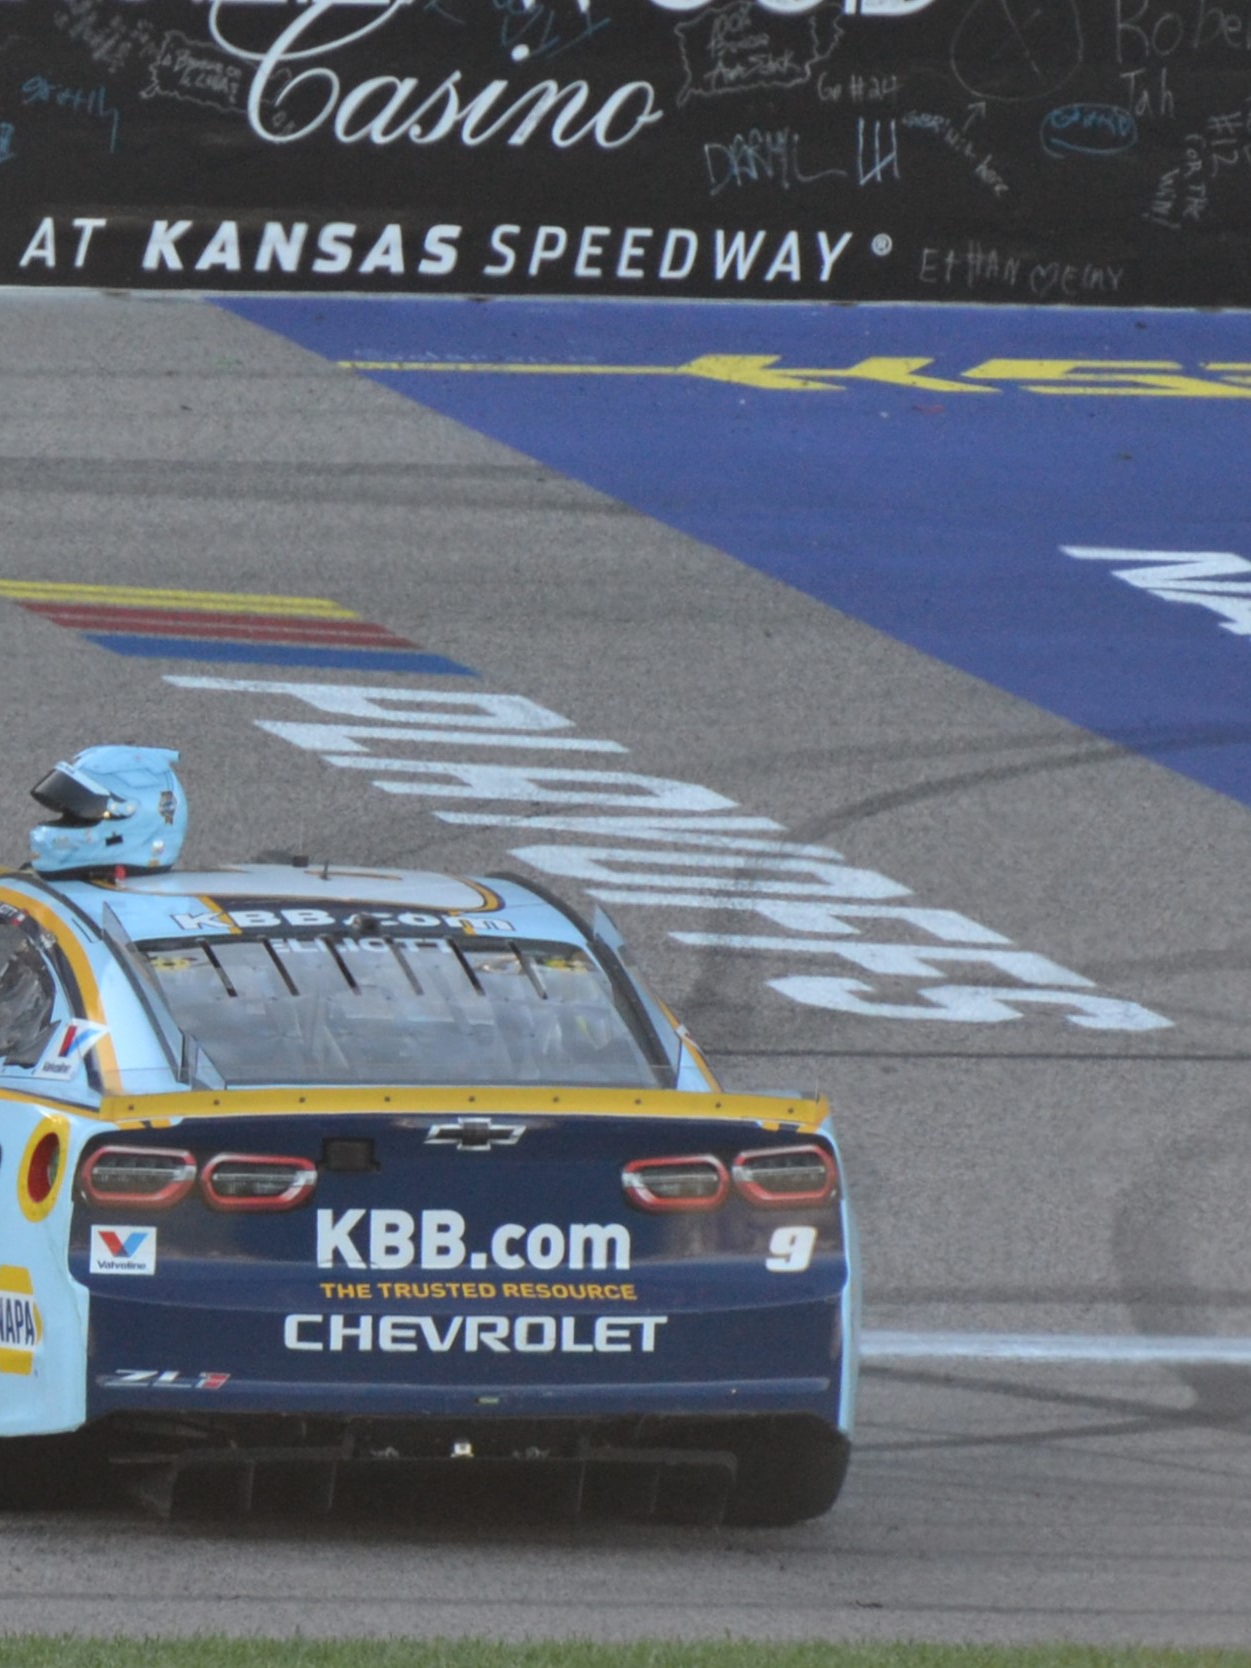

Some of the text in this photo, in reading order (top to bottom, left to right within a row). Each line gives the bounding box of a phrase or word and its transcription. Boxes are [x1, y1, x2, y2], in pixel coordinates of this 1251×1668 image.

[208, 0, 663, 148] Casino
[19, 216, 853, 283] AT KANSAS SPEEDWAY
[316, 1208, 632, 1269] KBB.com
[766, 1225, 817, 1273] 9
[97, 1260, 147, 1271] Valvoline
[320, 1282, 638, 1300] THE TRUSTED RESOURCE
[284, 1314, 668, 1352] CHEVROLET
